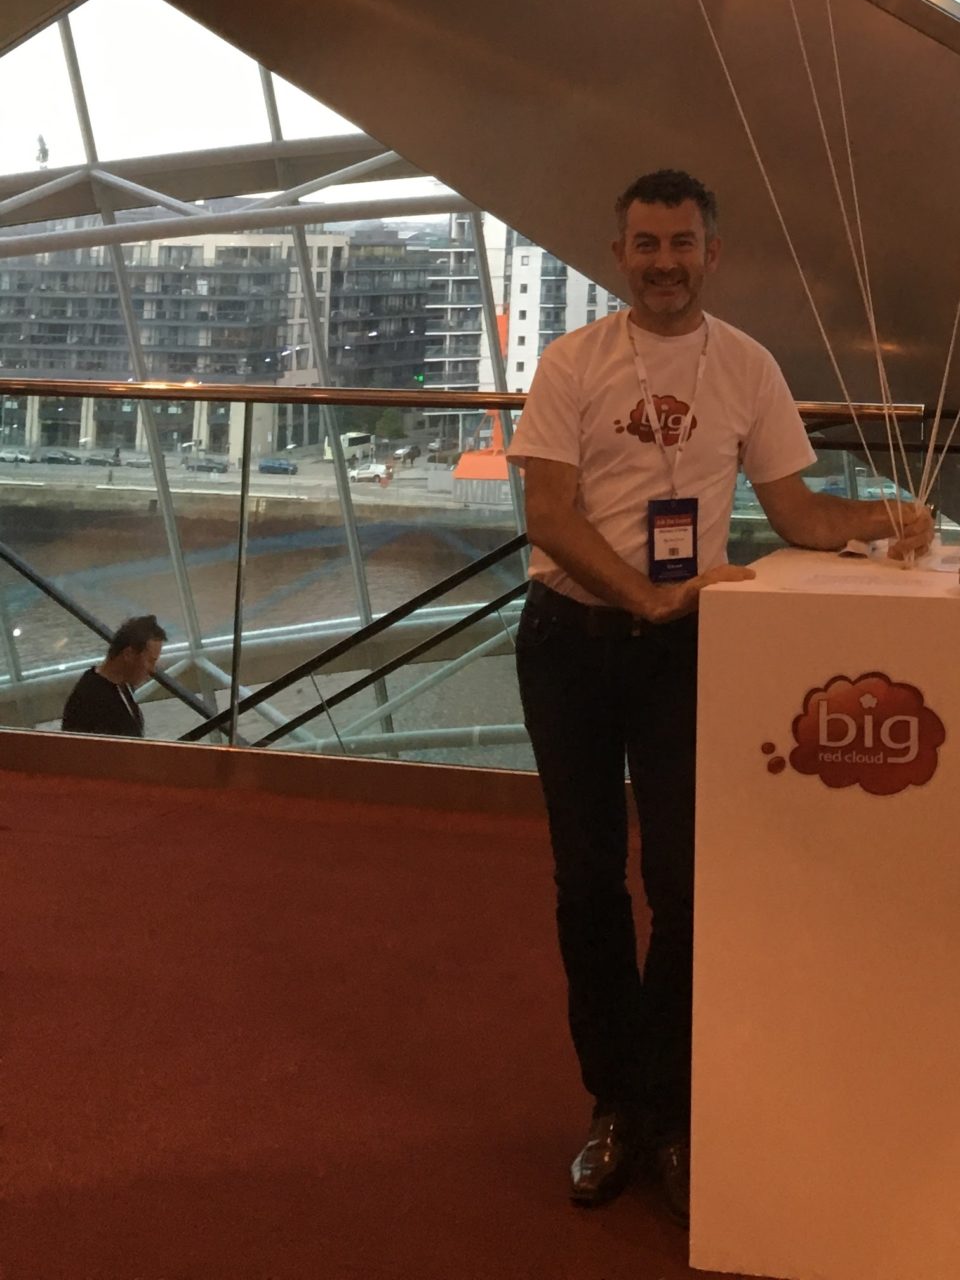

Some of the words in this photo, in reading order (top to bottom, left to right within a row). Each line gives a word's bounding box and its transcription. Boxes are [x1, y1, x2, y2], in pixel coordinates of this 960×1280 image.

[818, 694, 920, 764] big
[818, 749, 842, 763] red
[844, 750, 884, 765] cloud
